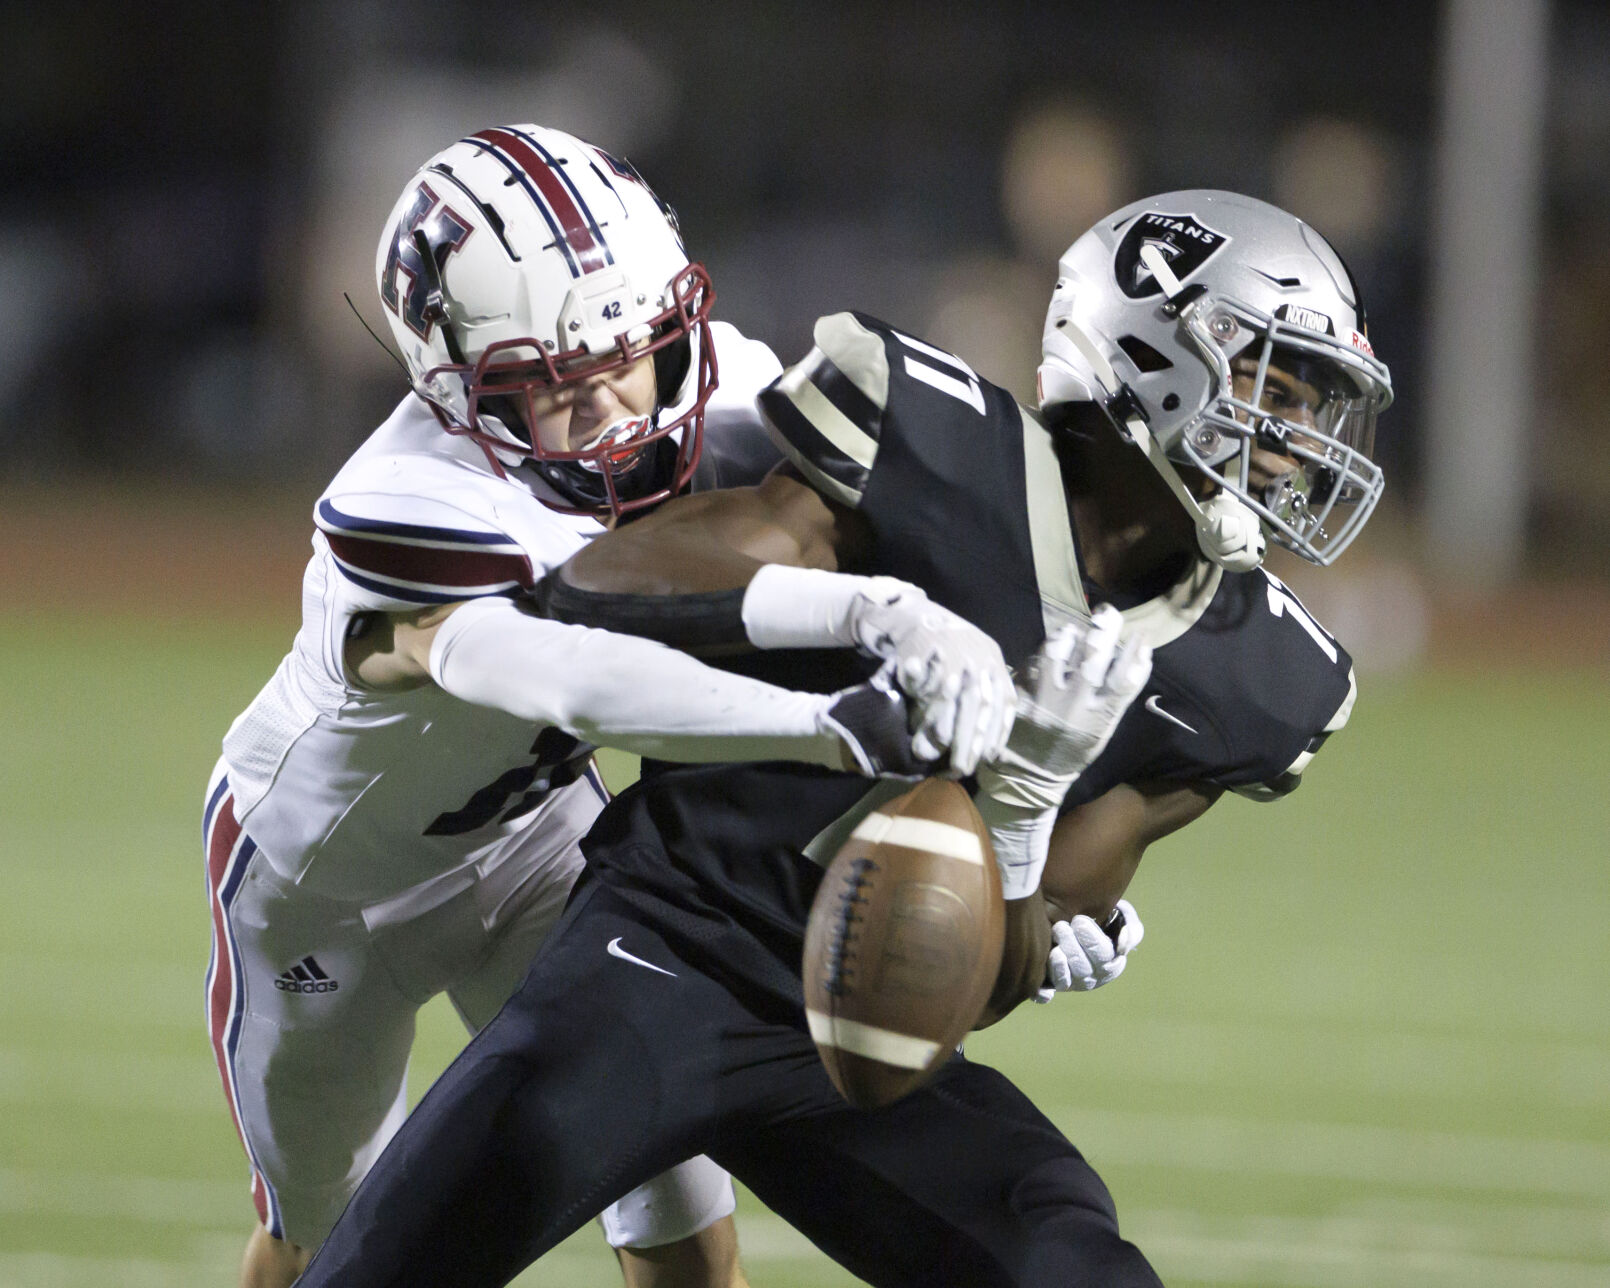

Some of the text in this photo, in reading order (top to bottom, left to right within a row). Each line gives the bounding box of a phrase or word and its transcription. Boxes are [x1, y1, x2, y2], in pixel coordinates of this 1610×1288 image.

[1146, 215, 1215, 244] TITANS
[602, 301, 622, 320] 42
[1285, 304, 1329, 334] NXTRND
[274, 979, 339, 994] adidas
